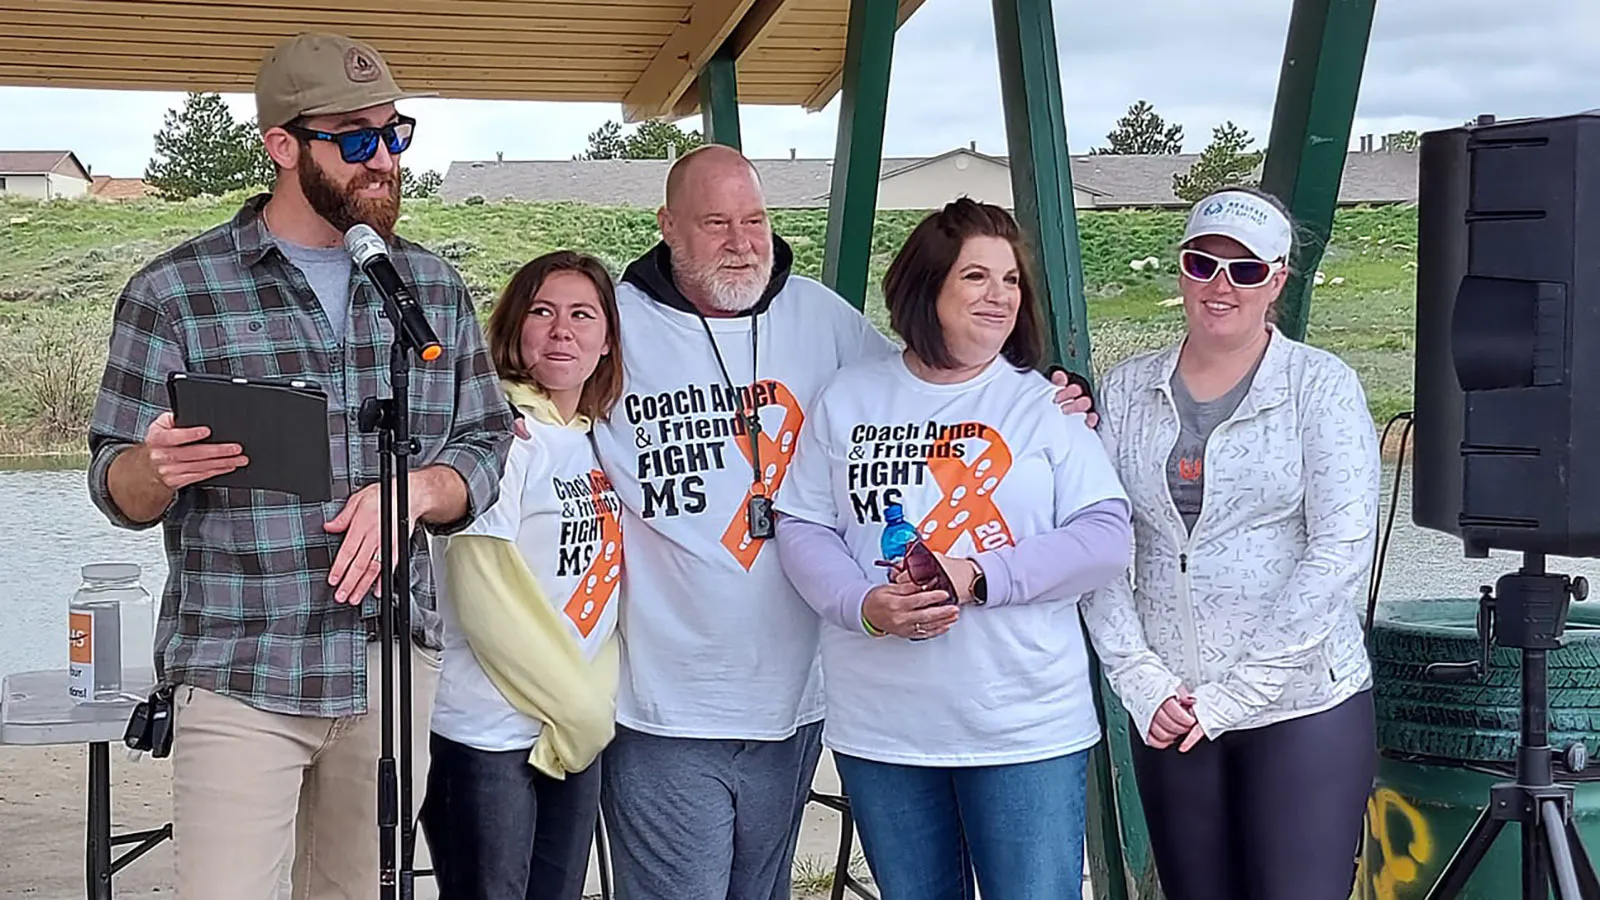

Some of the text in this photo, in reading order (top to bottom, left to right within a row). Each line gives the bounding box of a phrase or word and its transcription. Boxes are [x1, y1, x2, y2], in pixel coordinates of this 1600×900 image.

[624, 384, 706, 425] Coach
[635, 408, 747, 448] & Friend
[852, 421, 987, 444] Coach Arner
[638, 442, 725, 479] FIGHT
[848, 442, 965, 460] & Friends
[848, 461, 928, 490] FIGHT
[562, 495, 618, 518] & Friends
[641, 476, 707, 519] MS
[560, 516, 606, 545] FIGHT
[556, 545, 594, 576] MS
